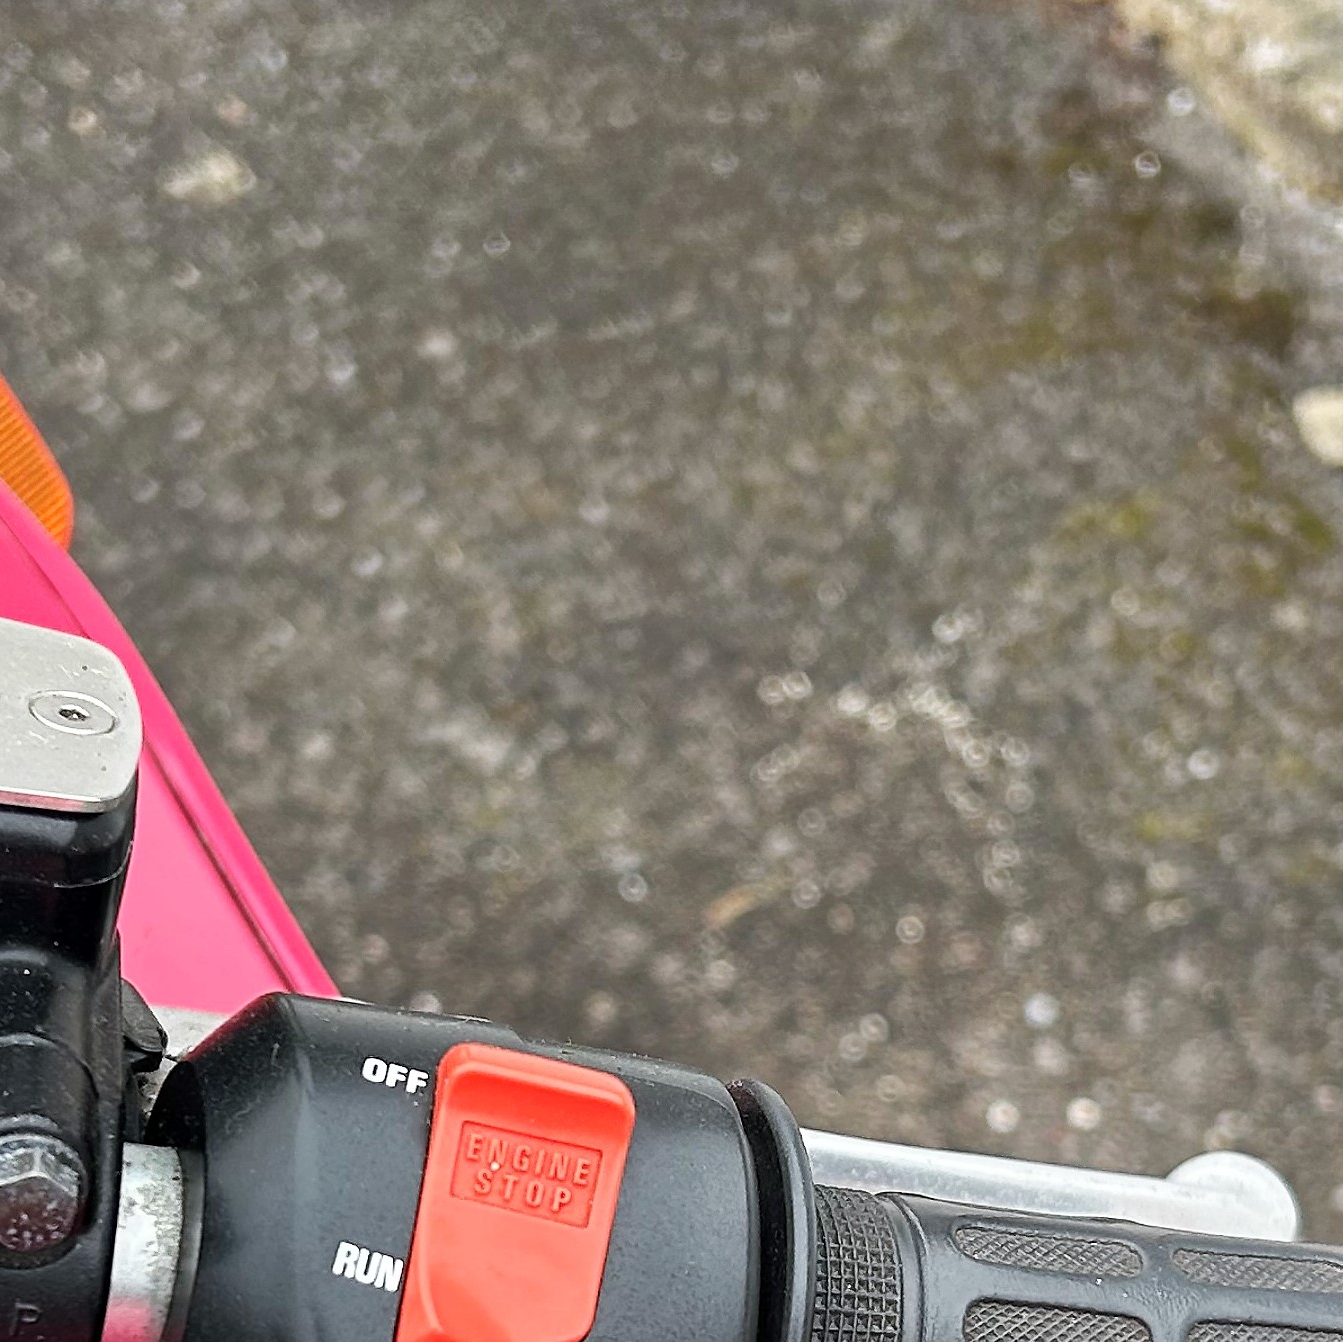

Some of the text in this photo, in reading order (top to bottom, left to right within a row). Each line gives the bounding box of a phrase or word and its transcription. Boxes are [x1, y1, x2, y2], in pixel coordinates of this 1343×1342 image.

[362, 1057, 429, 1093] OFF
[466, 1133, 592, 1186] ENGINE
[473, 1168, 572, 1213] STOP
[332, 1241, 404, 1292] RUN
